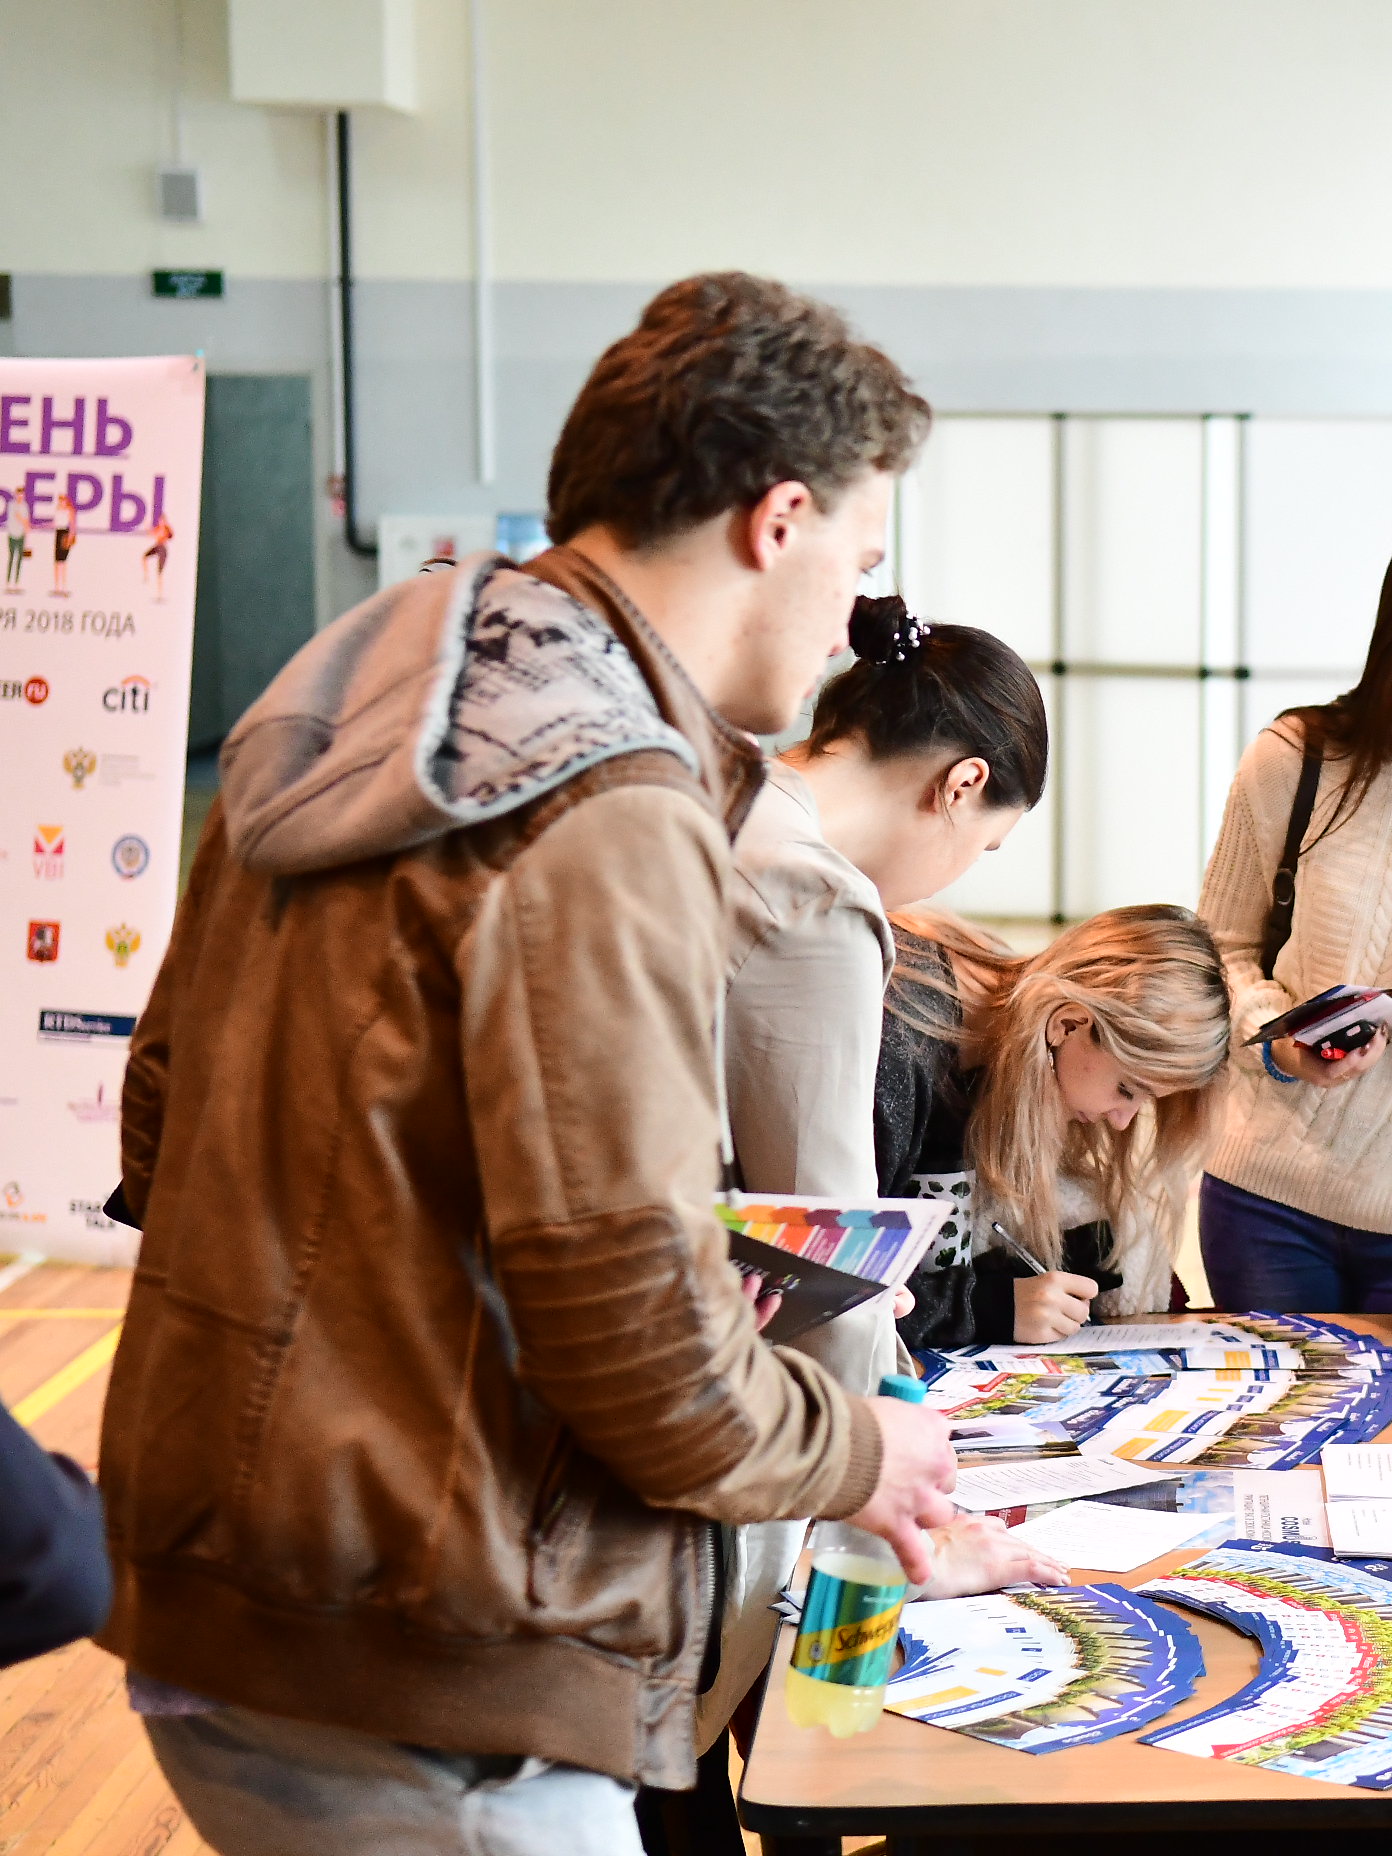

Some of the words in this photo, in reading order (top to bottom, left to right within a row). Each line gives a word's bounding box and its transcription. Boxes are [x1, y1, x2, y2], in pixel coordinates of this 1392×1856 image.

[0, 395, 133, 456] ЕНЬ
[24, 609, 75, 634] 2018
[81, 610, 136, 640] ГОДА
